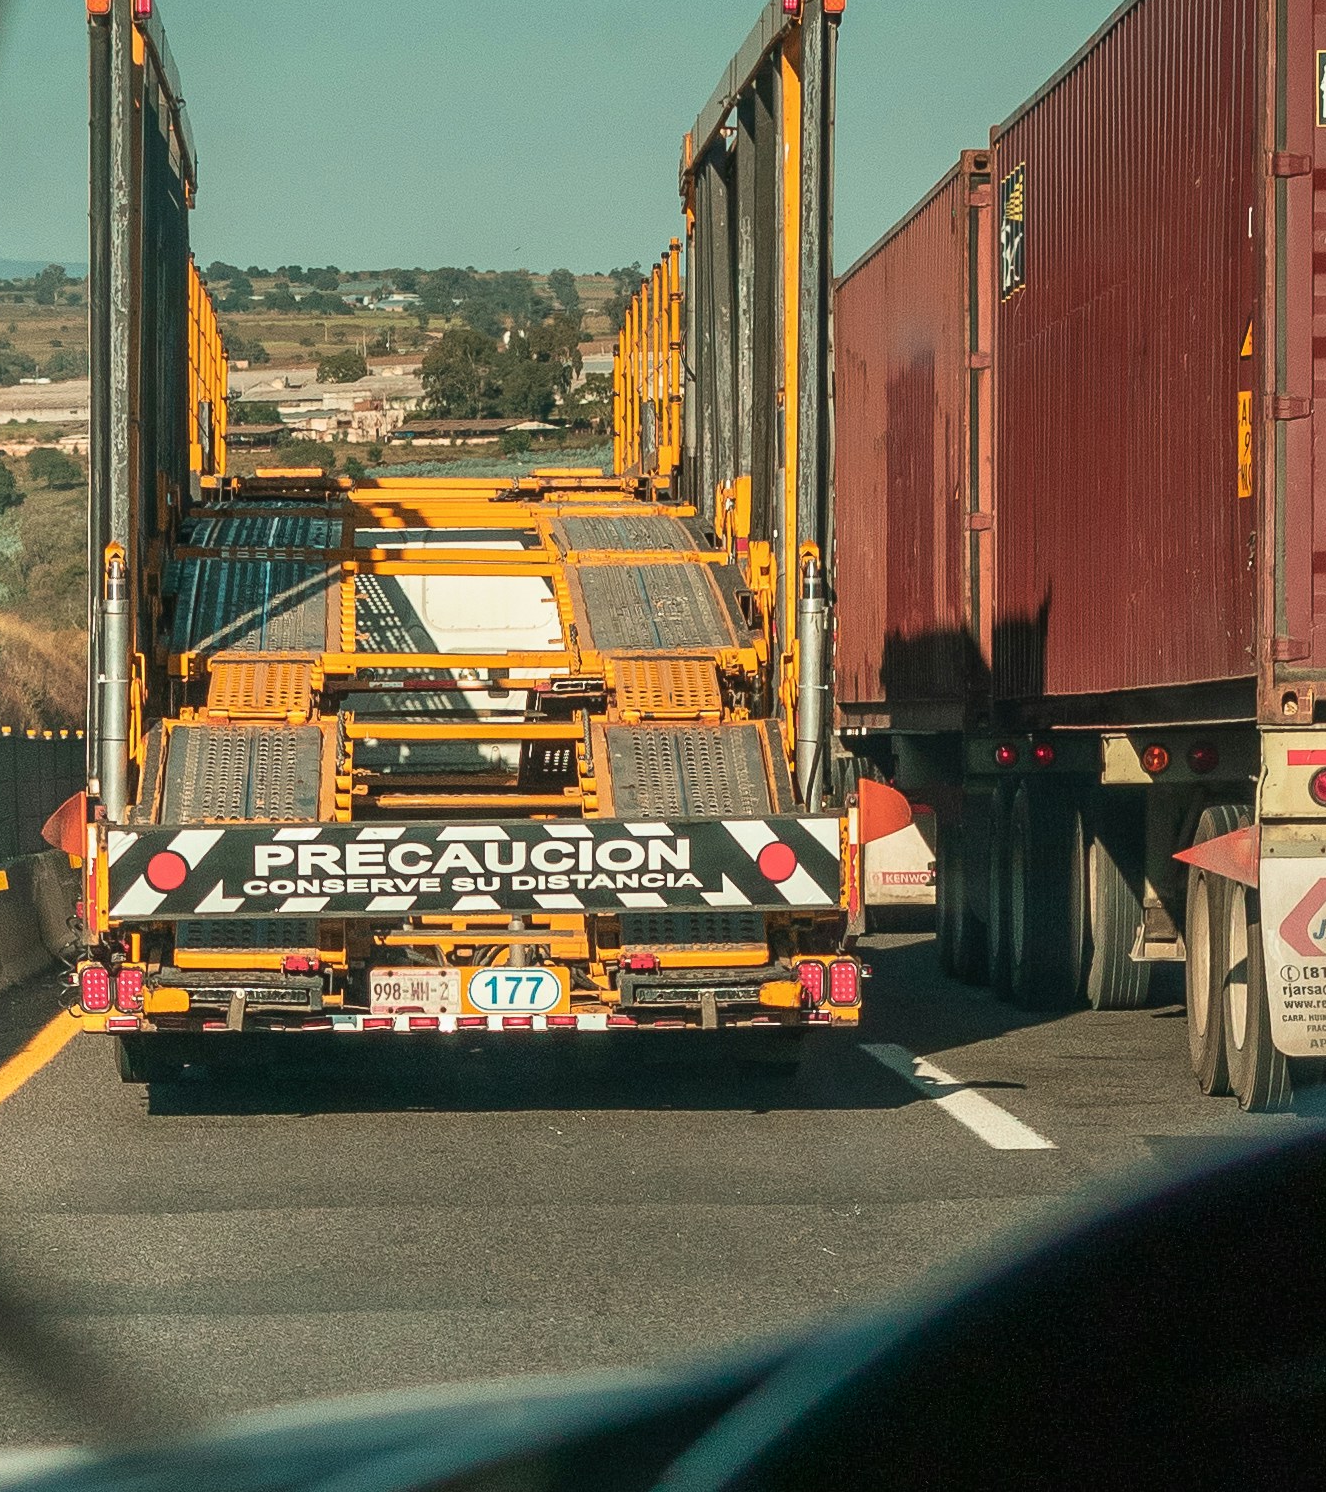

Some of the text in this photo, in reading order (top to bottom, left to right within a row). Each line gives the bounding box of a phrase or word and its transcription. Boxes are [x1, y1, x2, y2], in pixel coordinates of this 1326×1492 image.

[252, 837, 692, 877] PRECAUCION
[242, 871, 704, 896] CONSERVE SU DISTANCIA
[885, 873, 930, 884] KENWO
[484, 975, 544, 1005] 177
